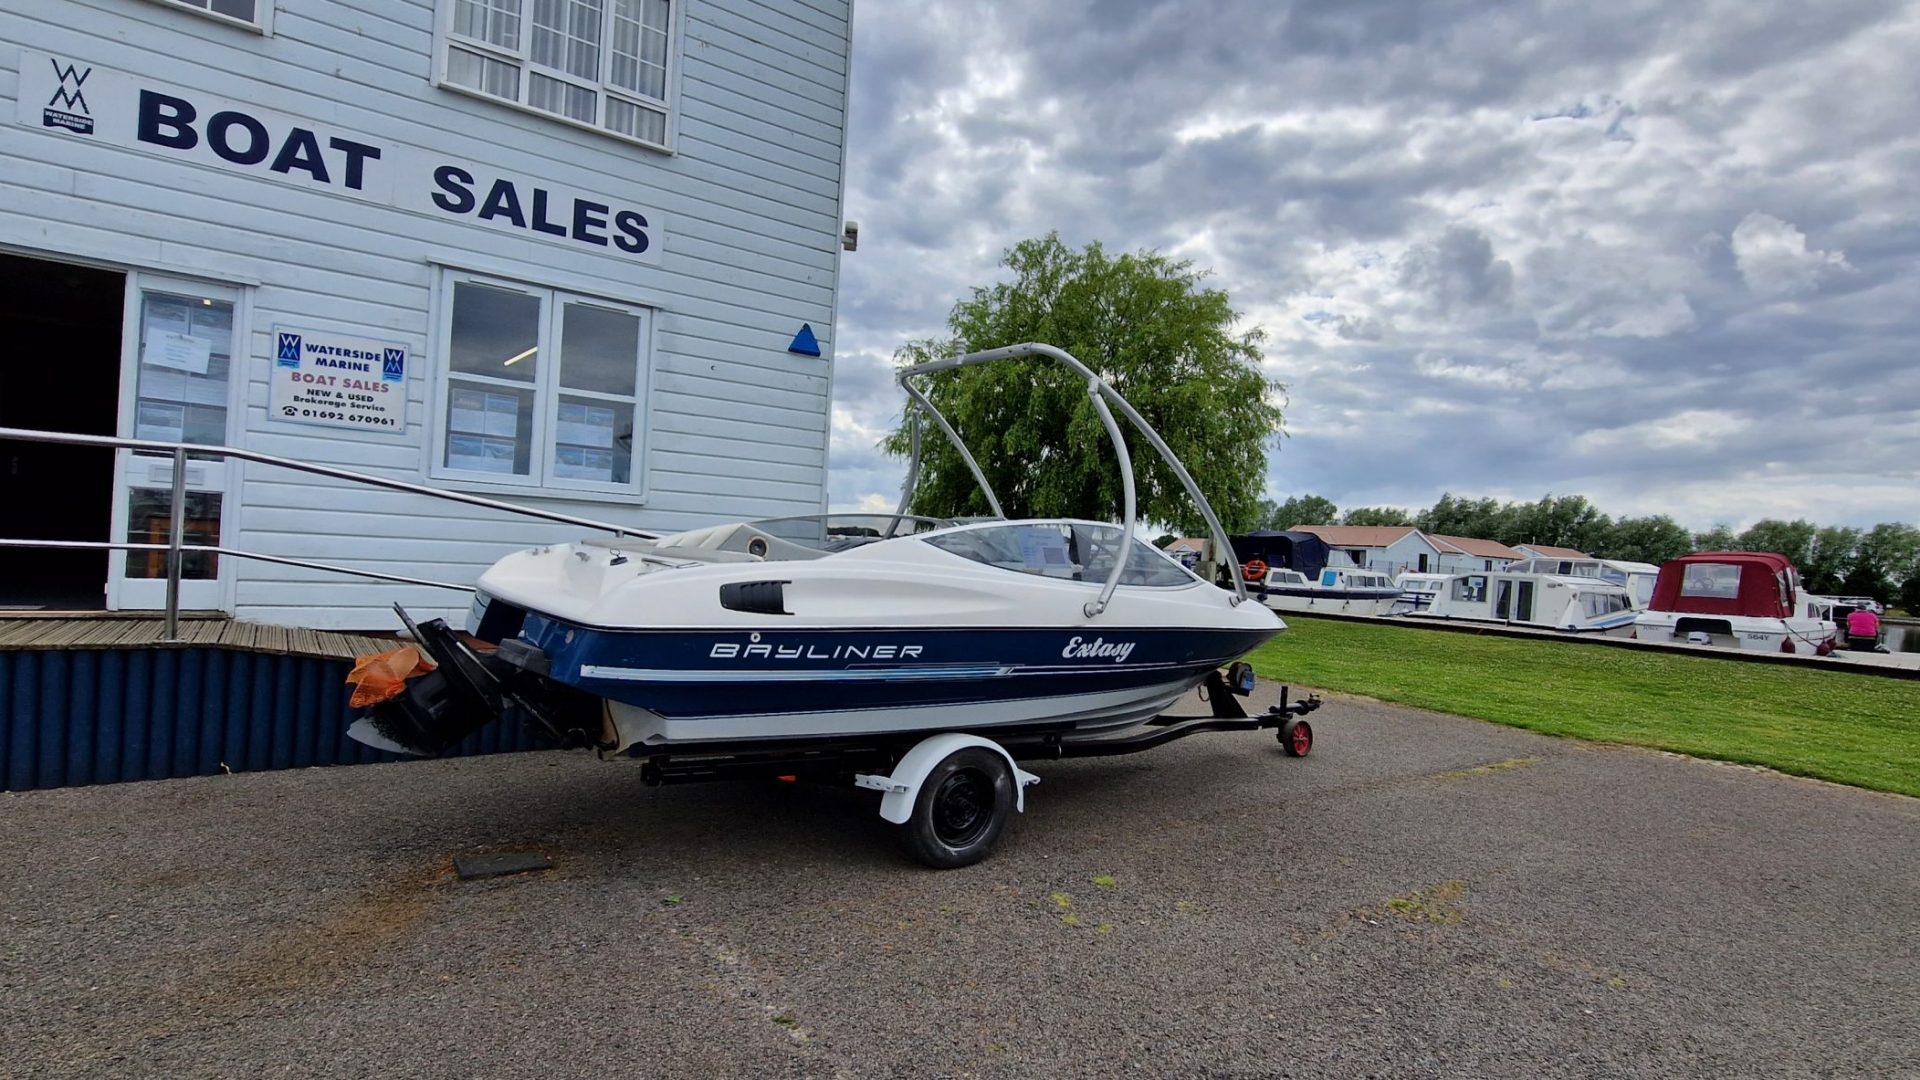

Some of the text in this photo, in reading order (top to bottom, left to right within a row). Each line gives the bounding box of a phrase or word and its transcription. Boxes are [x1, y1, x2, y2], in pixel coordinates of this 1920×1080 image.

[44, 110, 93, 126] WATERSIDE
[52, 117, 87, 130] MARINE
[137, 89, 650, 254] BOAT SALES
[305, 343, 382, 362] WATERSIDE
[315, 357, 371, 373] MARINE
[291, 372, 389, 393] BOAT SALES
[293, 395, 385, 412] Brokerage Service
[307, 388, 331, 398] NEW
[348, 393, 374, 403] USED
[302, 409, 395, 426] 01692 670961
[709, 643, 924, 659] BAYLINER
[1062, 636, 1136, 663] Extasy
